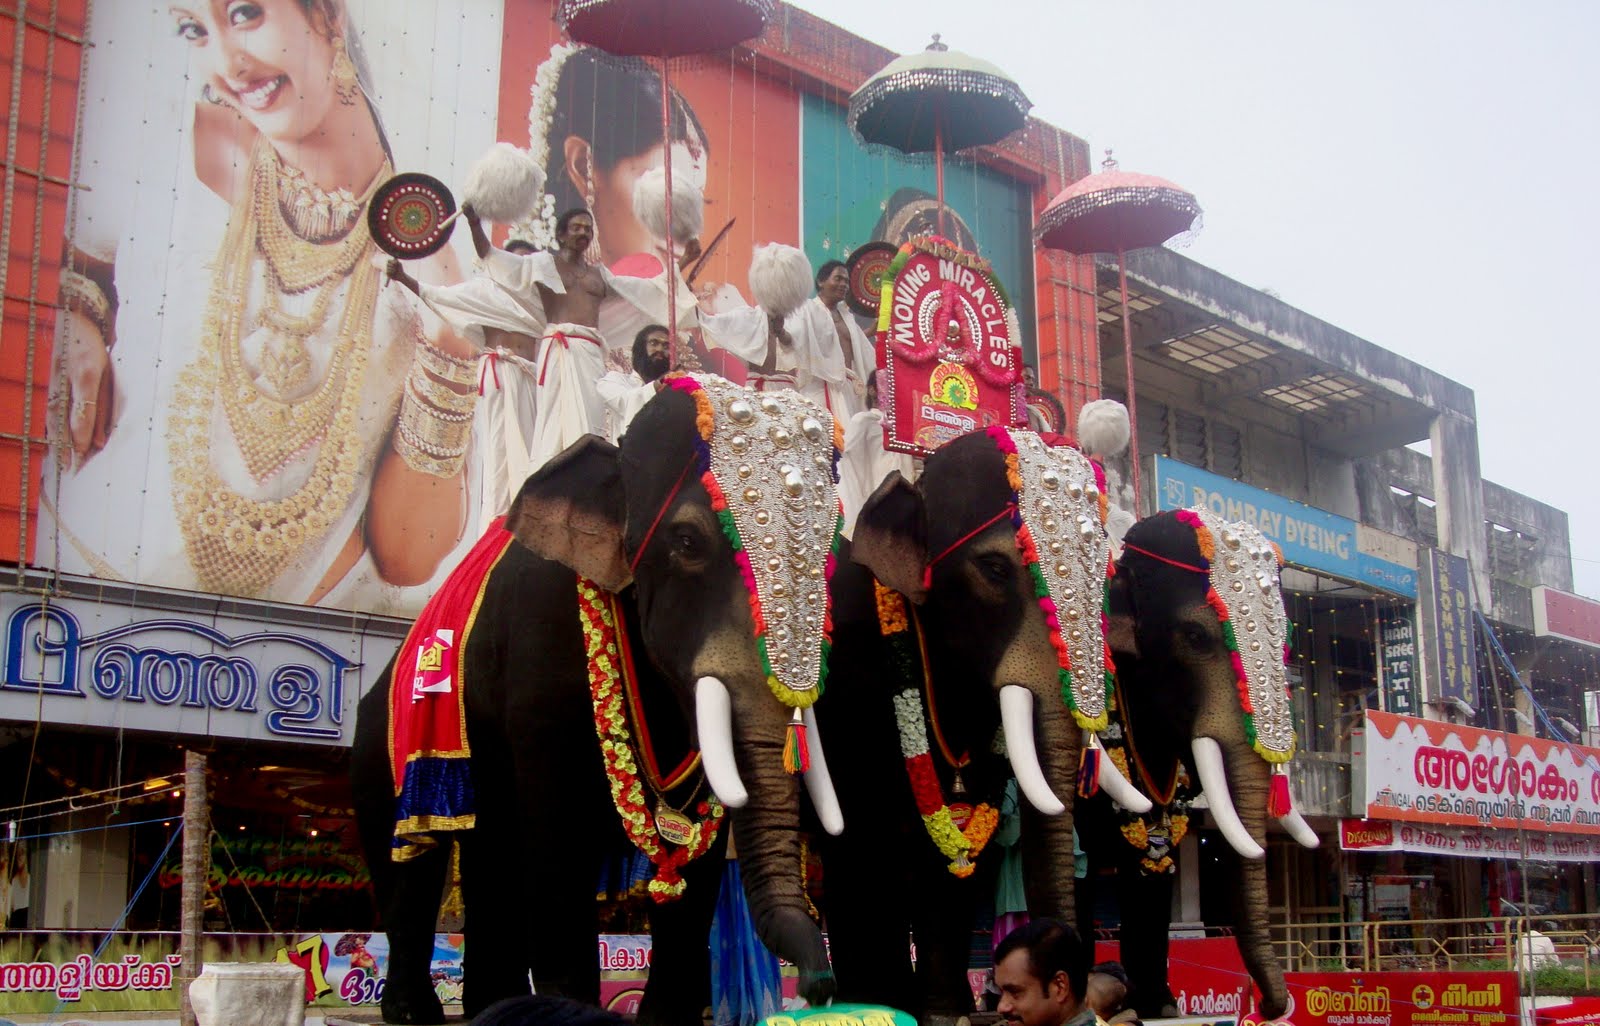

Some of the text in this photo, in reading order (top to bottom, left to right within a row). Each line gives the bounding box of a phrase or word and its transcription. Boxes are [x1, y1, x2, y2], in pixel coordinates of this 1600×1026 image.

[894, 259, 1008, 368] MOVING MIRACLES
[1192, 486, 1283, 537] BOMBAY
[1285, 516, 1350, 560] DYEING
[1385, 625, 1412, 641] HARI
[1385, 643, 1413, 658] SREE
[1439, 573, 1456, 688] BOMBAY
[1456, 589, 1473, 703] DYEING
[1414, 745, 1579, 802] അശോകം
[1347, 827, 1393, 844] DISCOUNT
[1400, 826, 1456, 849] ഓണം
